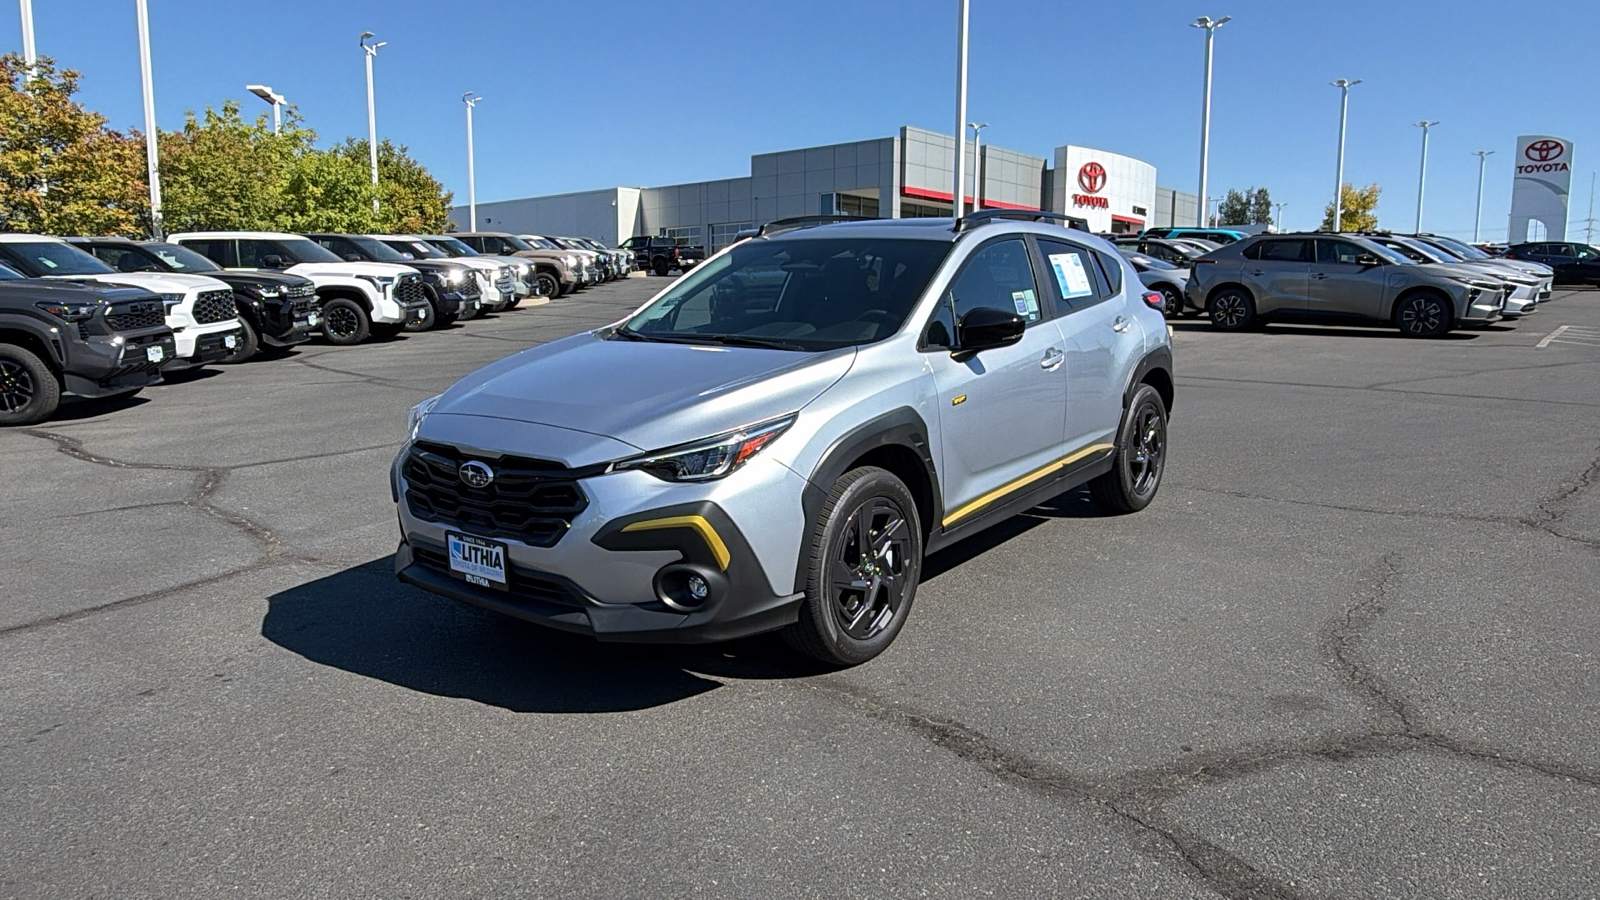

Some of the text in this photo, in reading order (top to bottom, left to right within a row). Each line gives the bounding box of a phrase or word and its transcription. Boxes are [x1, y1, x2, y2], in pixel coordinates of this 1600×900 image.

[1516, 162, 1569, 174] TOYOTA
[1072, 194, 1109, 209] TOYOTA
[462, 543, 503, 571] LITHIA
[452, 559, 470, 569] TOYOTA
[470, 576, 490, 587] LITHIA
